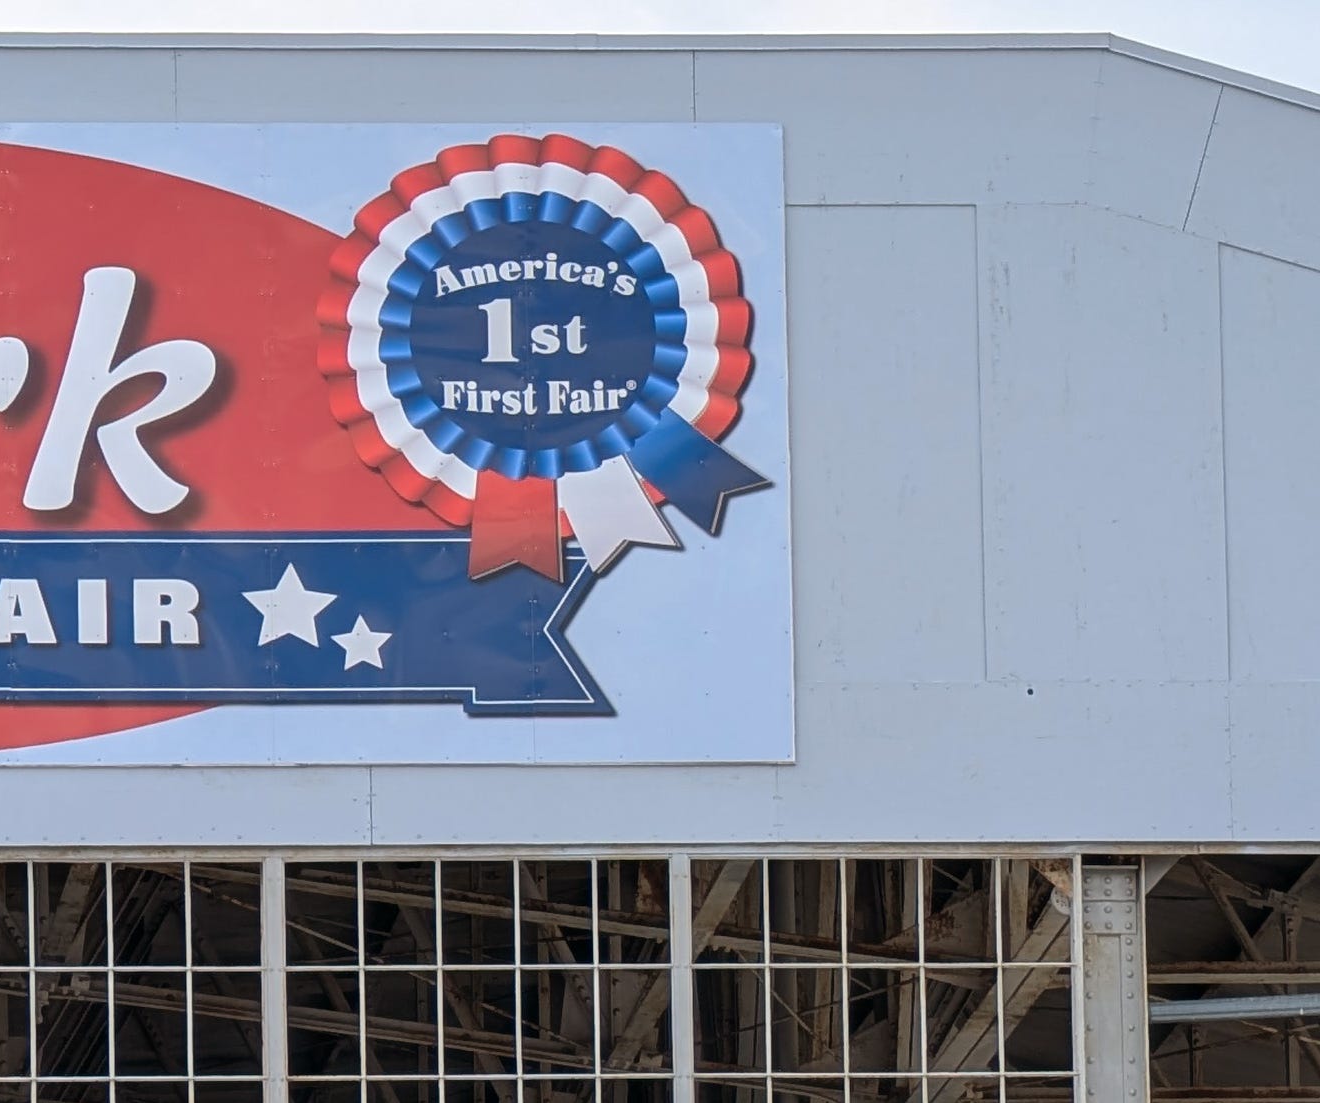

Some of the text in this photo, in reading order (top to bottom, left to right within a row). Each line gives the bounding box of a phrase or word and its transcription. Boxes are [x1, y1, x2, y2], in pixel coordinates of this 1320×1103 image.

[434, 252, 637, 297] America's
[477, 298, 588, 363] 1st
[441, 380, 538, 416] First
